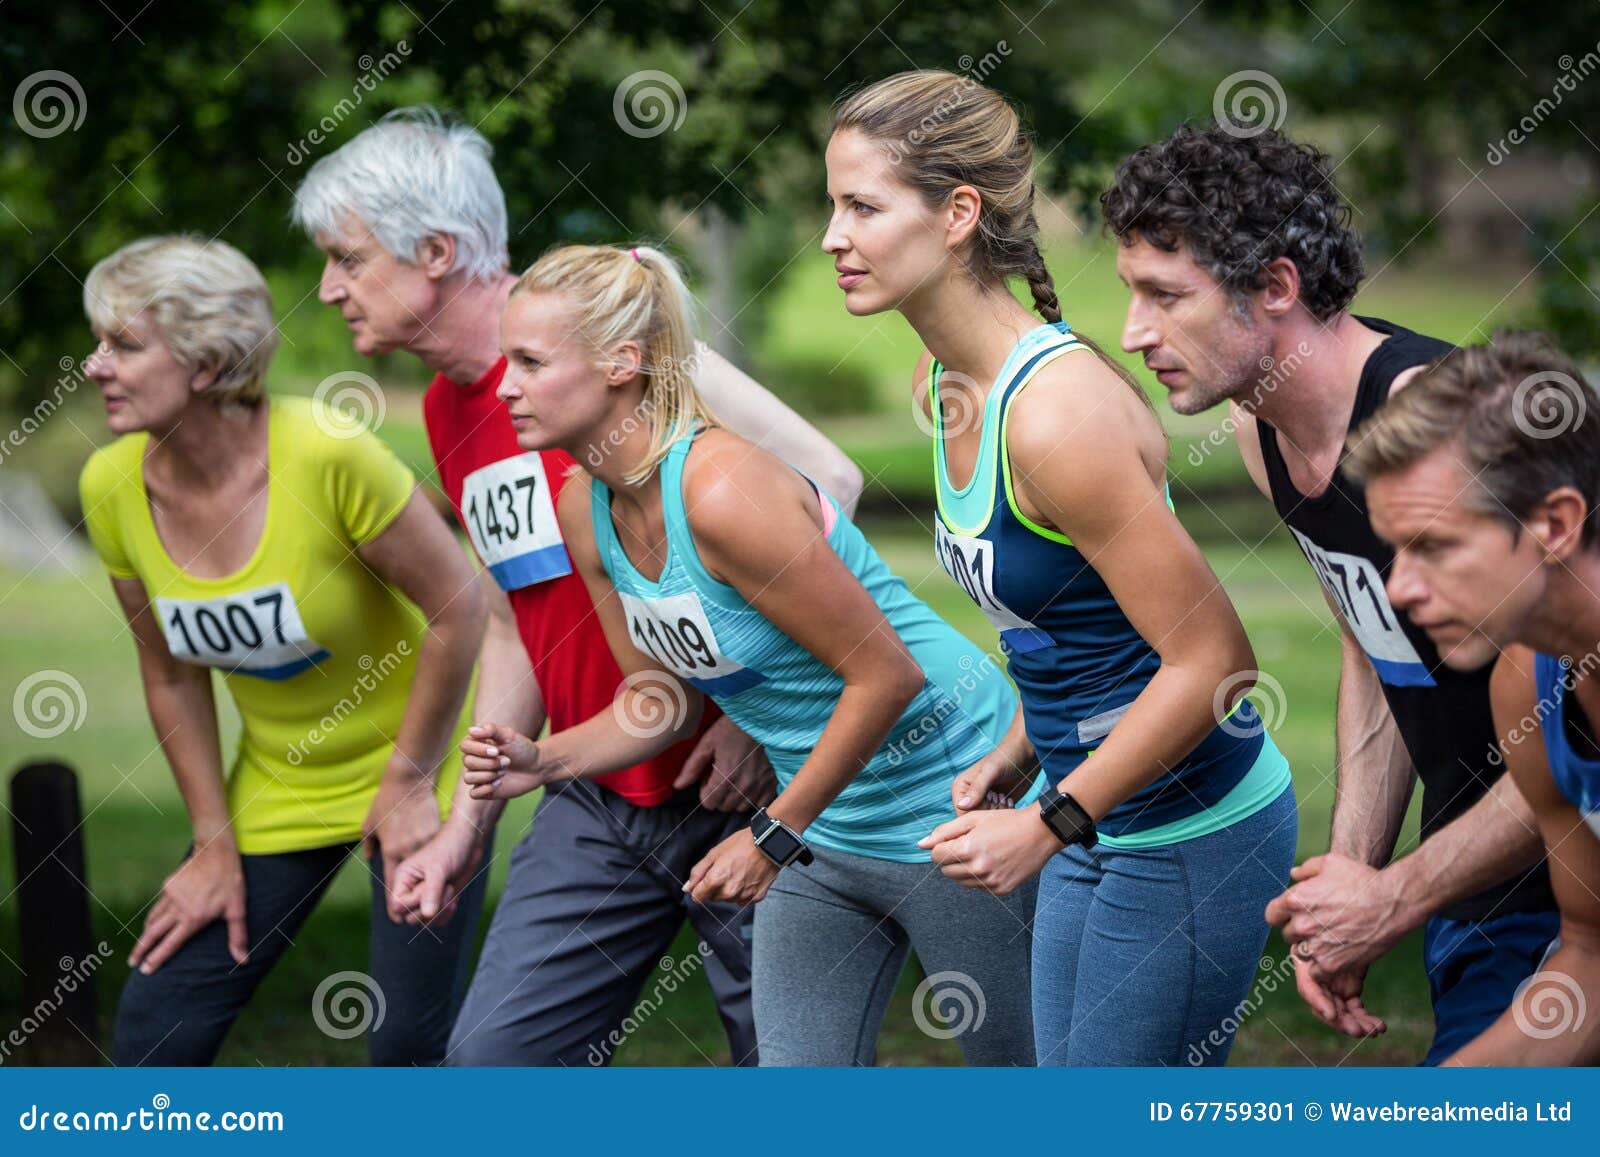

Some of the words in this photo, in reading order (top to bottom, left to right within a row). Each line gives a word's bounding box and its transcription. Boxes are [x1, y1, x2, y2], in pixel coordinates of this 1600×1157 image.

[469, 476, 536, 552] 1437
[170, 592, 287, 656] 1007
[633, 615, 717, 669] 1109
